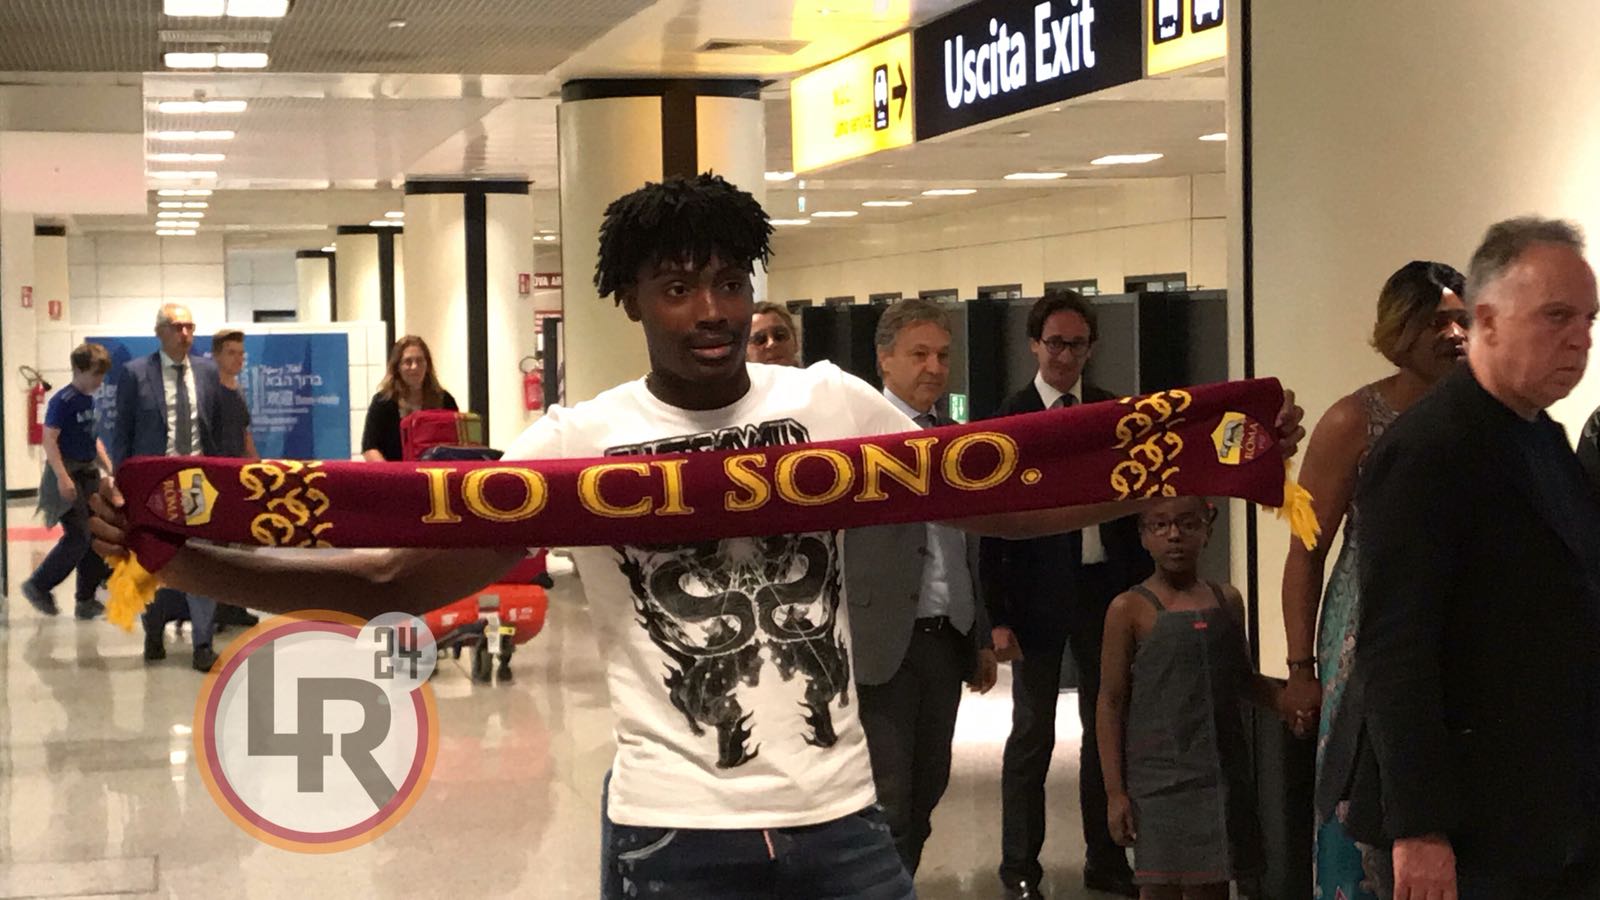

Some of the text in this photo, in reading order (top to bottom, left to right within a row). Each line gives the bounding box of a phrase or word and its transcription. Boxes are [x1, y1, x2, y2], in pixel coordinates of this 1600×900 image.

[944, 0, 1096, 109] Uscita Exit
[1244, 422, 1260, 460] ROMA
[162, 480, 180, 521] ROMA
[416, 467, 548, 523] IO
[577, 459, 695, 518] CI
[723, 431, 1042, 511] SONO.
